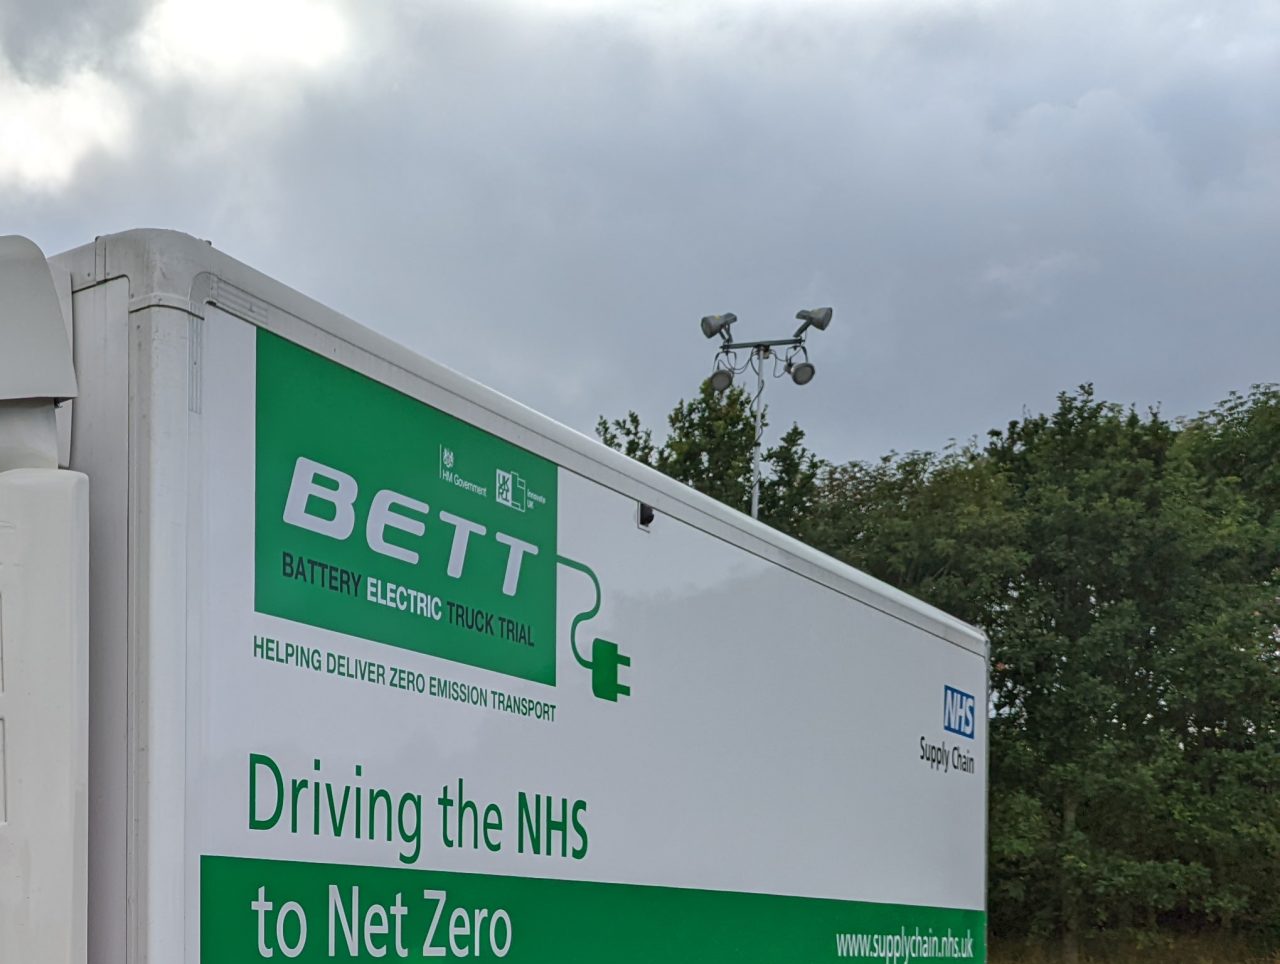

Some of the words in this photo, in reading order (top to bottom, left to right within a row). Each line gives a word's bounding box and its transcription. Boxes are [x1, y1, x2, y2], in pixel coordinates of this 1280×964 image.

[442, 469, 453, 483] HM
[454, 474, 487, 497] Government
[282, 456, 540, 597] BETT
[282, 551, 362, 598] BATTERY
[367, 576, 442, 621] ELECTRIC
[447, 600, 495, 636] TRUCK
[499, 616, 536, 648] TRIAL
[253, 635, 322, 672] HELPING
[326, 653, 386, 687] DELIVER
[389, 666, 425, 694] ZERO
[429, 676, 488, 708] EMISSION
[491, 690, 556, 723] TRANSPORT
[944, 689, 974, 735] NHS
[920, 735, 950, 774] Supply
[951, 745, 975, 774] Chain
[249, 752, 422, 865] Driving
[437, 777, 504, 852] the
[517, 791, 589, 860] NHS
[250, 885, 308, 959] to
[328, 884, 409, 958] Net
[422, 889, 513, 958] Zero
